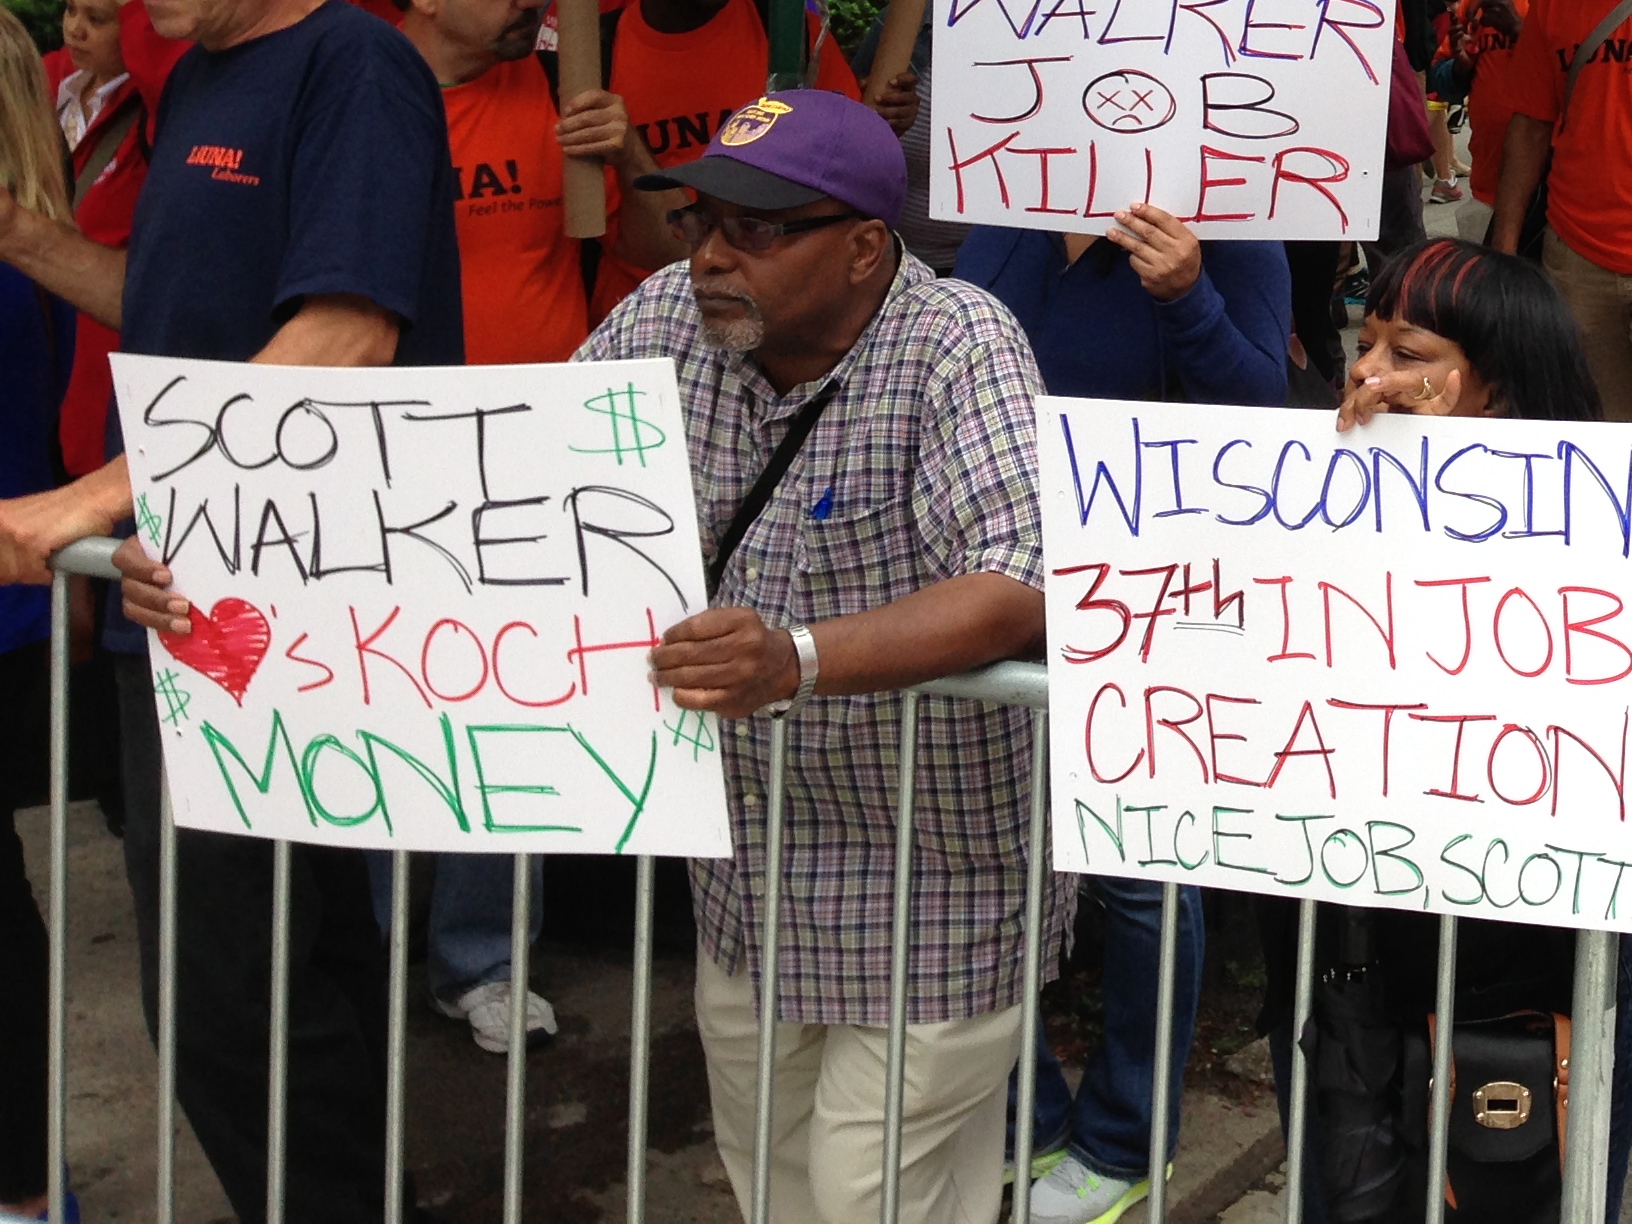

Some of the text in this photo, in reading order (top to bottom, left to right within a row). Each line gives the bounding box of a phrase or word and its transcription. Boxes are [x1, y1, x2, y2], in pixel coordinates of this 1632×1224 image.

[970, 55, 1300, 140] JOB
[469, 203, 497, 216] Feel
[501, 200, 525, 213] the
[947, 126, 1350, 235] KILLER
[144, 375, 532, 504] SCOTT
[162, 483, 689, 612] WALKER
[348, 604, 663, 712] KOCH
[1052, 557, 1246, 664] 37th
[1253, 571, 1397, 670] IN
[199, 708, 658, 853] MONEY
[1084, 682, 1630, 823] CREATION
[1074, 794, 1277, 876] NICE
[1274, 813, 1433, 910] JOB,
